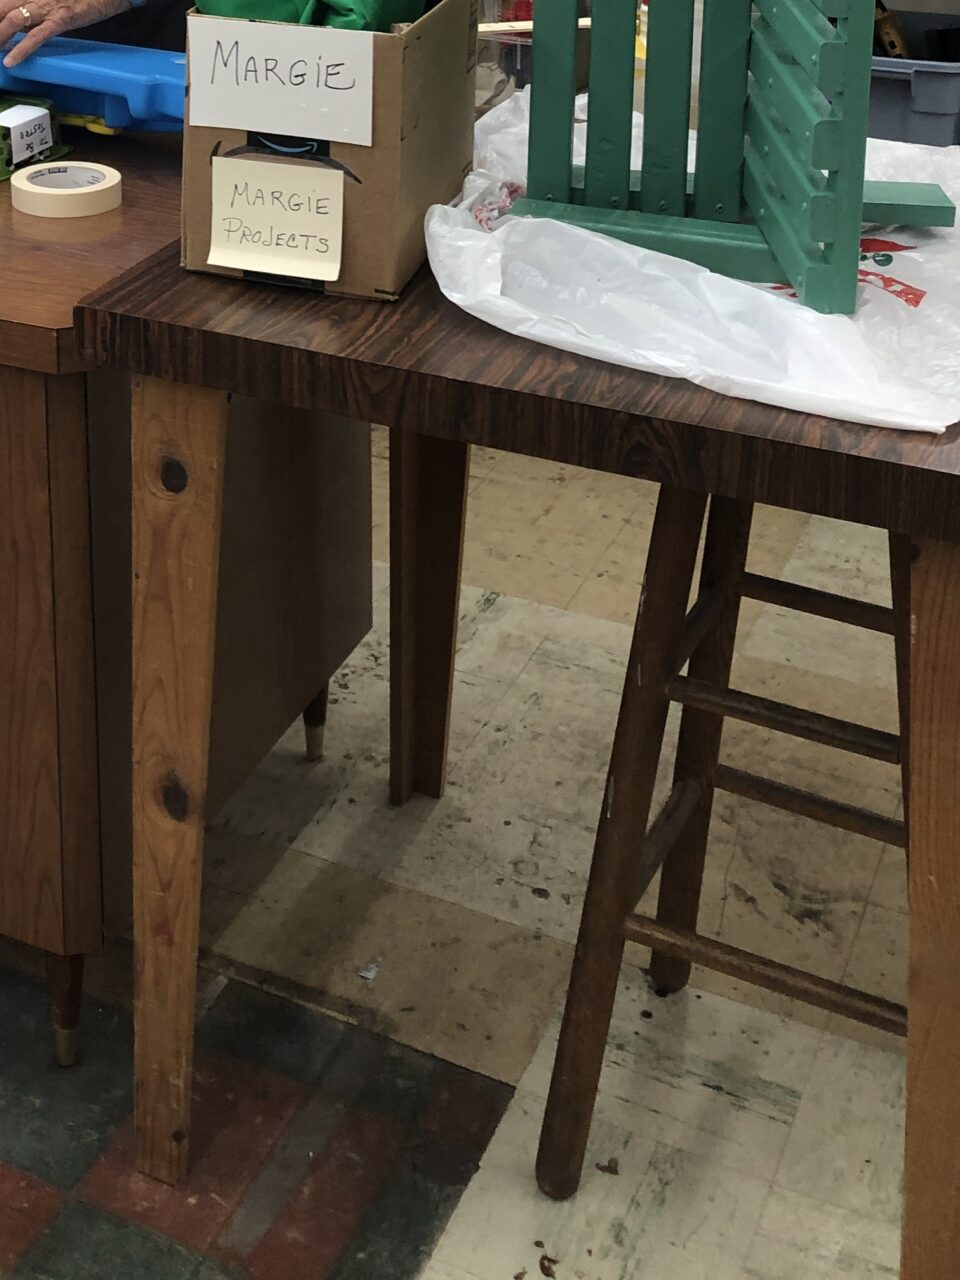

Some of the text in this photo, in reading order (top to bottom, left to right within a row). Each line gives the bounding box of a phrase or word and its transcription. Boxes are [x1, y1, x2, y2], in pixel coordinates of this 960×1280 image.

[210, 40, 356, 90] MARGIE
[230, 183, 331, 216] MARGIE
[222, 217, 330, 254] PROJECTS
